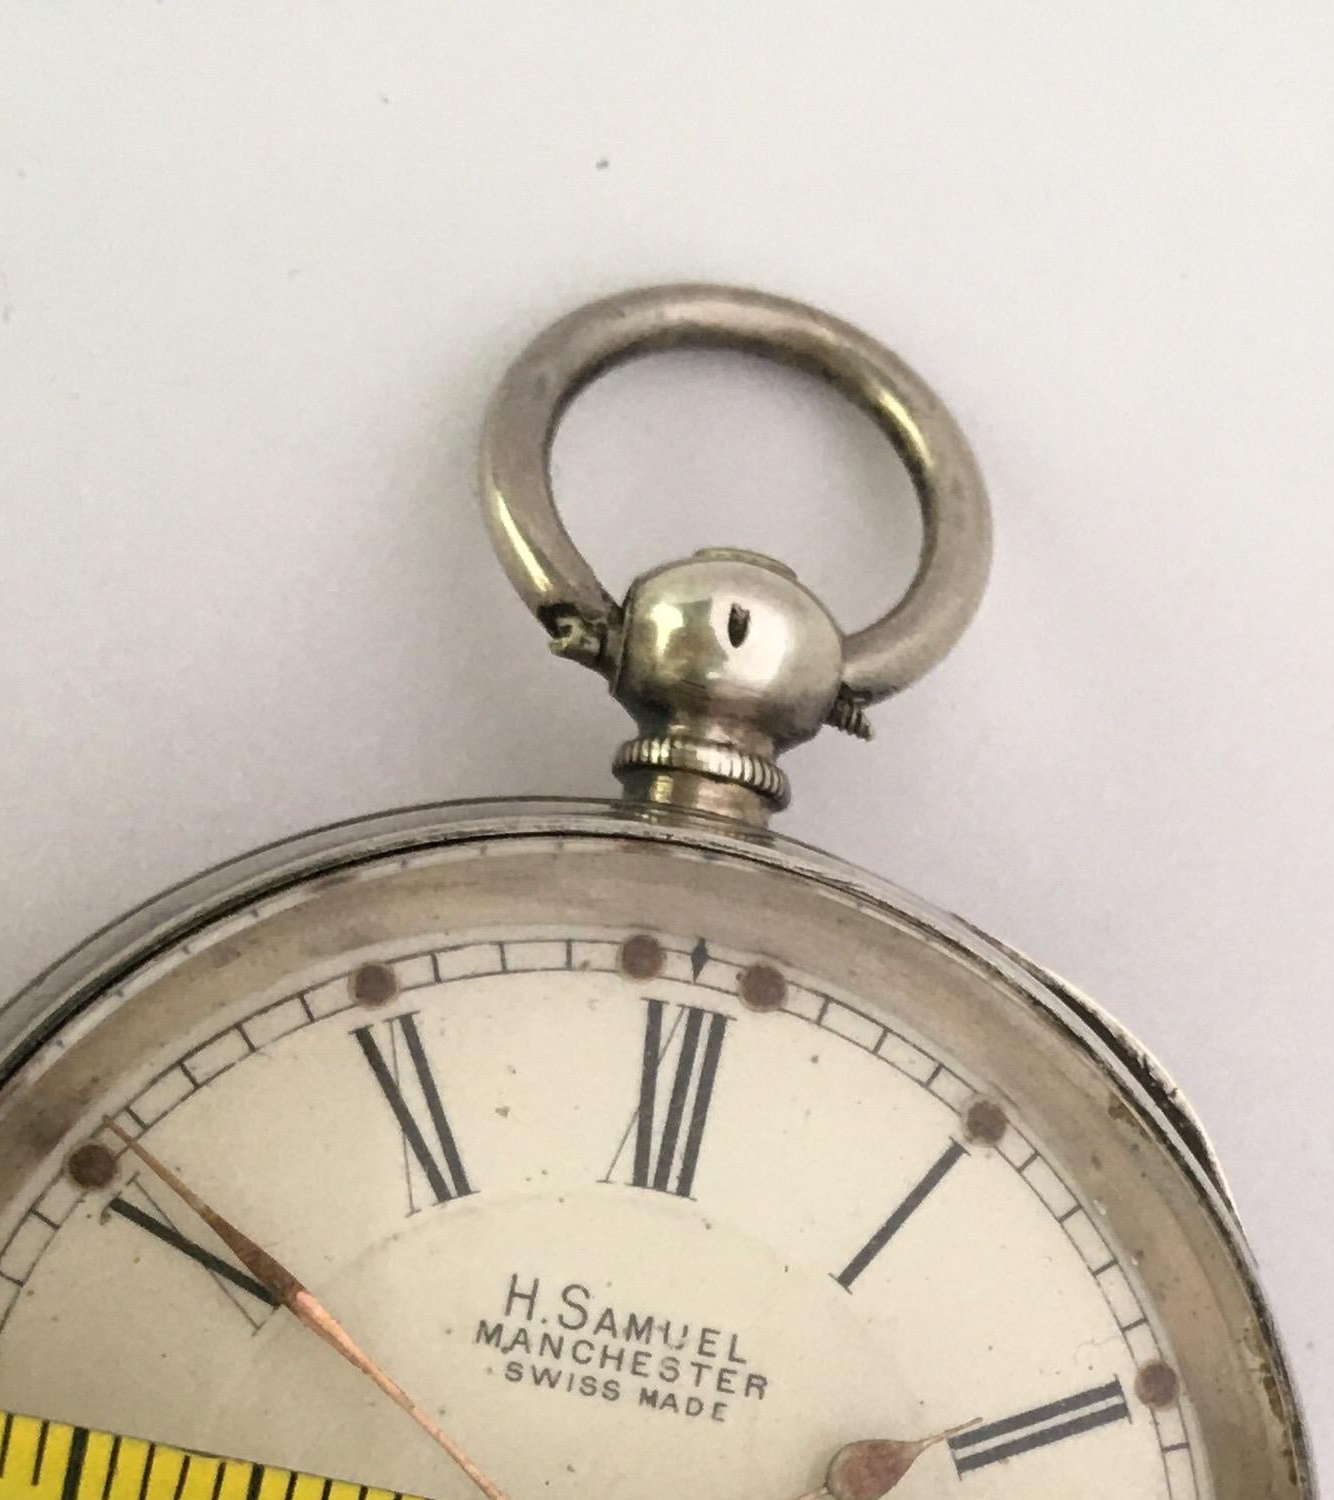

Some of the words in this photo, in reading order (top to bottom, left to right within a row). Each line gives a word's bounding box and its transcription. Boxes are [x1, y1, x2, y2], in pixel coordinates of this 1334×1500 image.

[349, 1010, 480, 1218] XI
[596, 997, 737, 1202] XII
[473, 1319, 769, 1400] MANCHESTER
[504, 1361, 622, 1401] SWISS
[638, 1386, 728, 1424] MADE
